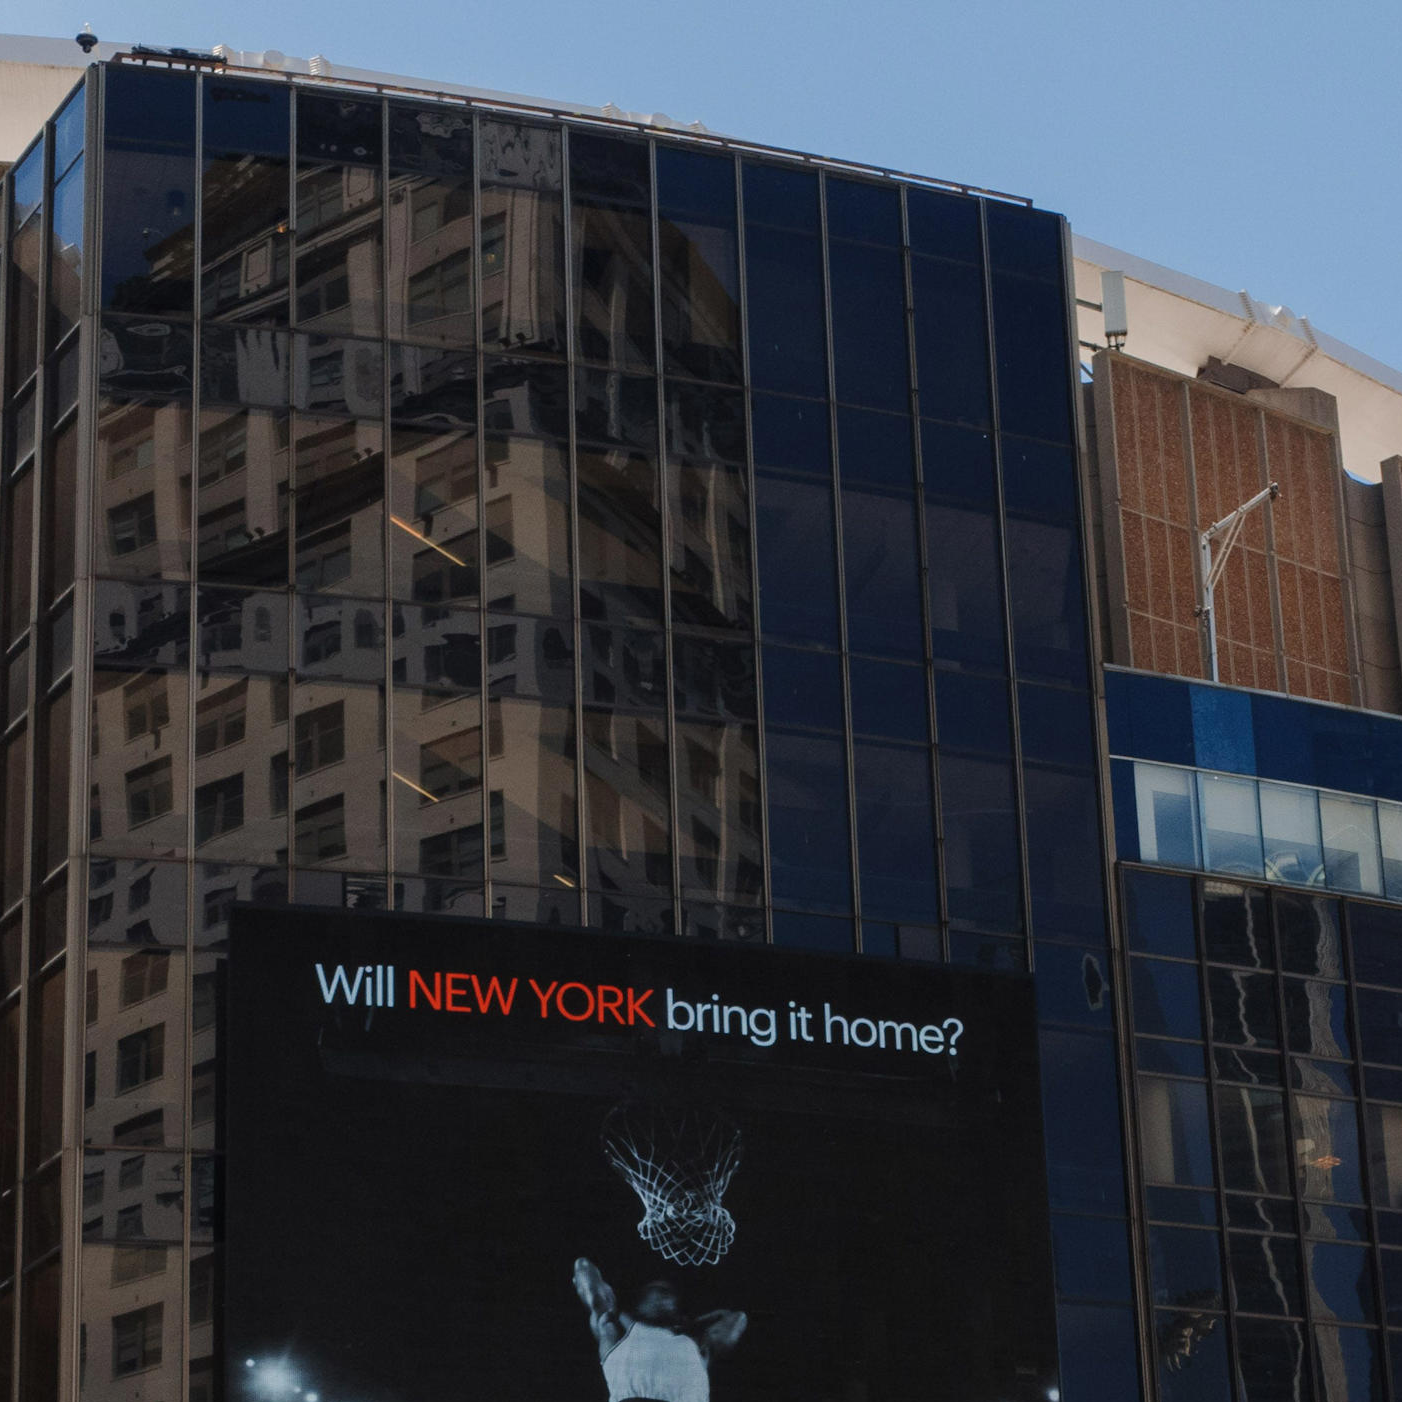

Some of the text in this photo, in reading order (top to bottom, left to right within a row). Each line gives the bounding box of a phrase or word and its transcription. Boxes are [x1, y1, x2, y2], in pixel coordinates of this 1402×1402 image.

[315, 963, 964, 1056] Will NEW YORK bring it home?
